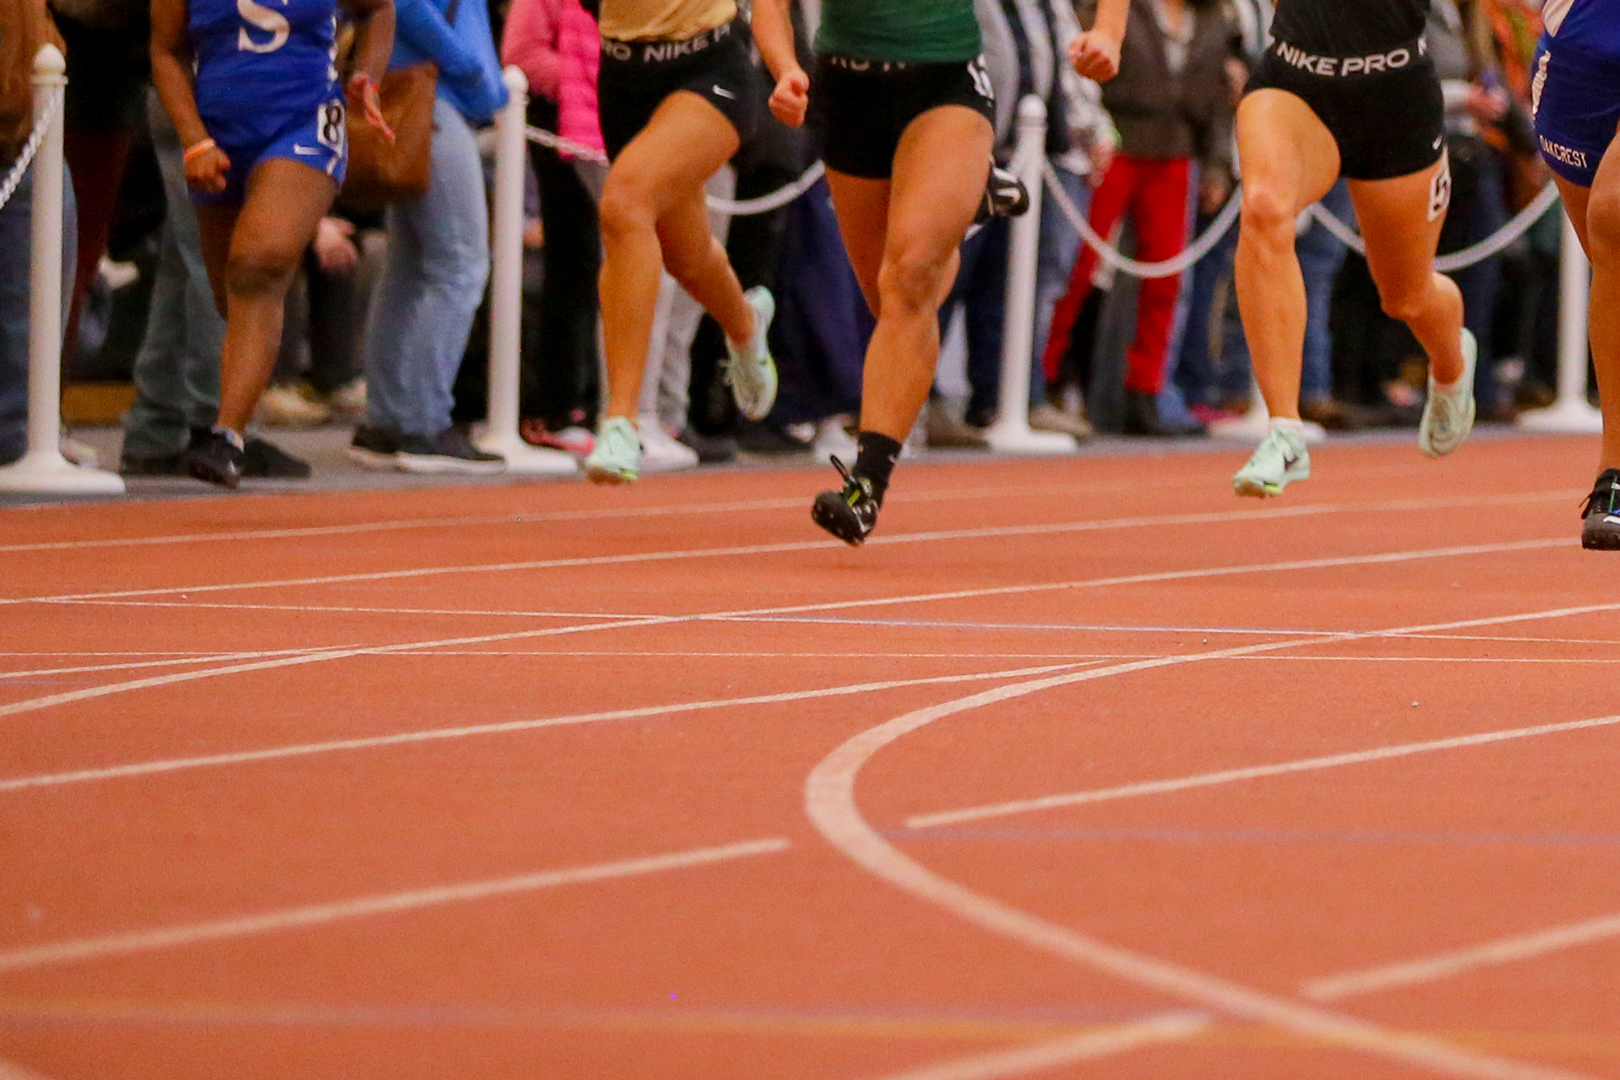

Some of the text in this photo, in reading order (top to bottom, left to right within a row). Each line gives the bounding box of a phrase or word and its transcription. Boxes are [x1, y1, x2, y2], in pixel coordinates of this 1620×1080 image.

[643, 36, 708, 62] NIKE
[1276, 41, 1409, 76] NIKE PRO
[323, 105, 341, 143] 8
[1540, 135, 1587, 168] OAKCREST
